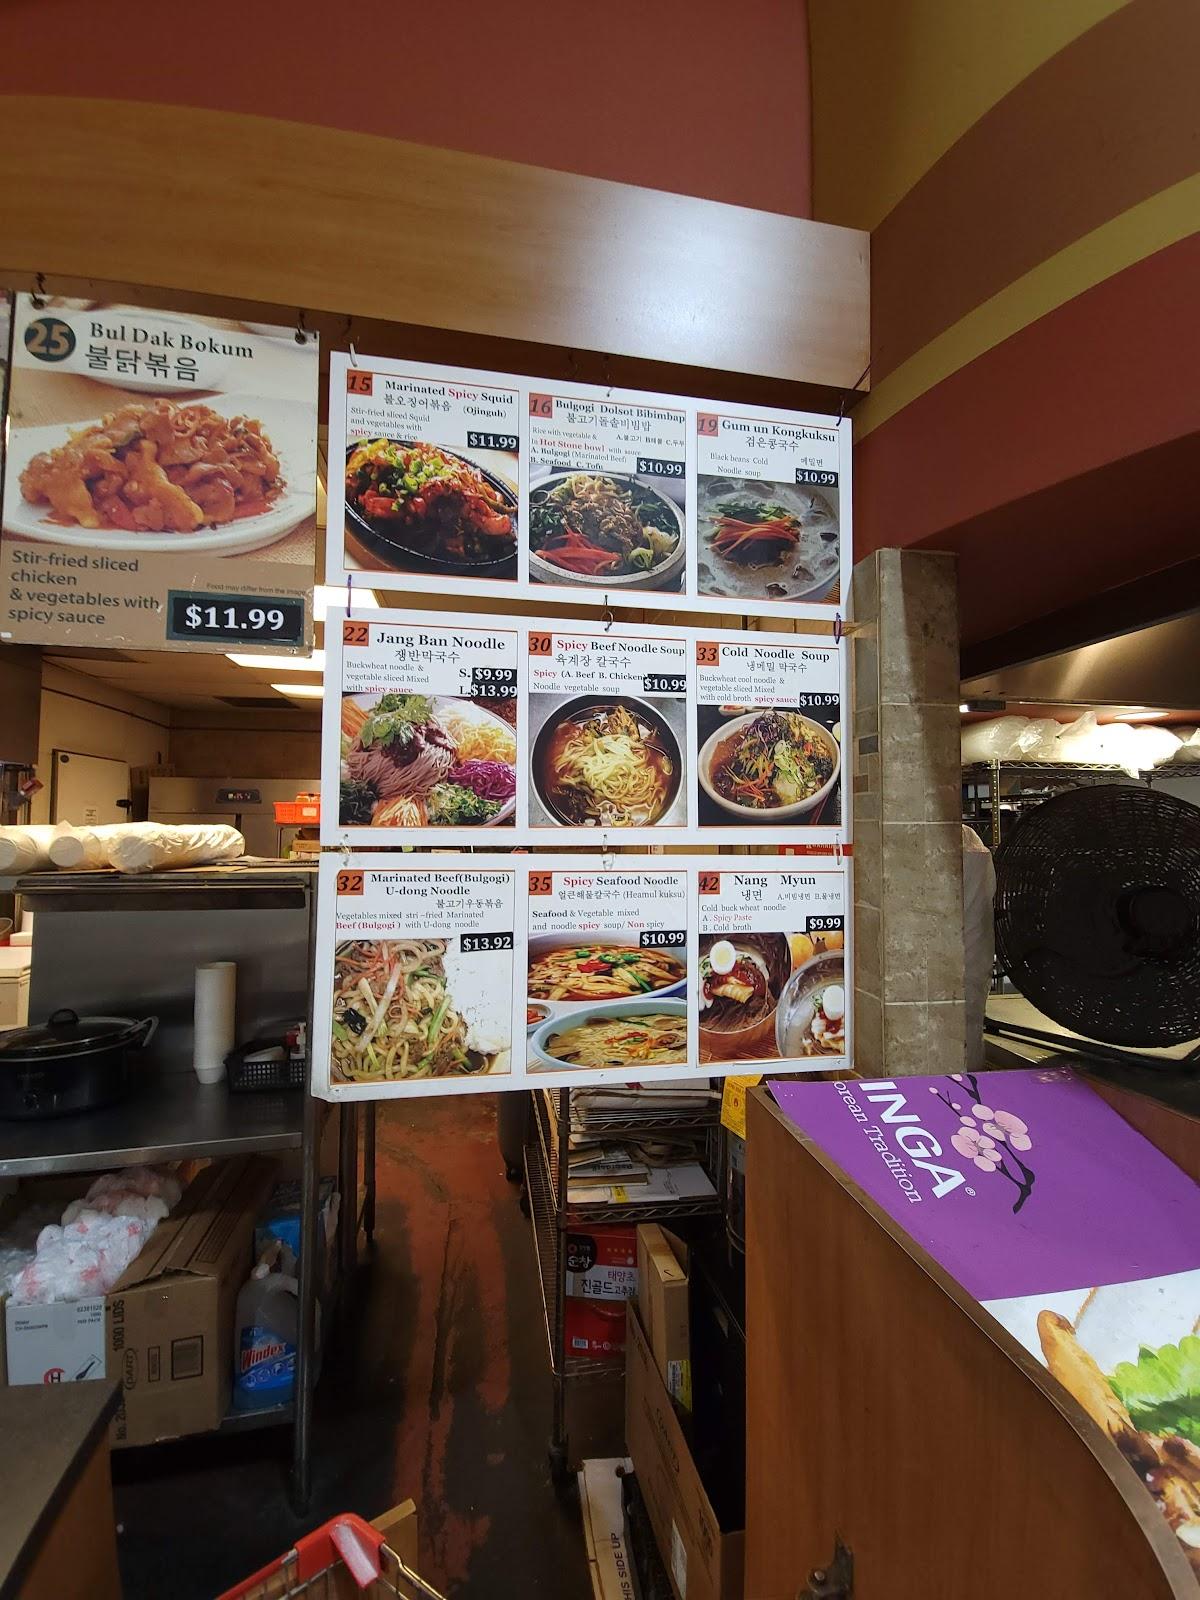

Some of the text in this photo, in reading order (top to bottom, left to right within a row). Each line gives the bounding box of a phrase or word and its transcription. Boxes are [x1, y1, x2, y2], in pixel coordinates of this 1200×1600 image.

[27, 322, 68, 355] 25
[90, 322, 254, 359] Bul Dak Bokum
[85, 345, 200, 382] 불닭볶음
[348, 375, 371, 391] 15
[385, 380, 513, 404] Marinated Spicy Squid
[463, 405, 507, 419] (Ojinguh)
[531, 399, 551, 414] 16
[556, 400, 685, 424] Bulgogi Dolsot Bibimbap
[351, 407, 430, 423] Stir-fried sliced Squid
[367, 420, 404, 431] vegetables
[406, 423, 422, 431] with
[699, 418, 717, 432] 19
[722, 420, 835, 442] Gum un Kongkuksu
[351, 429, 372, 438] spicy
[469, 433, 517, 448] $11.99
[540, 438, 605, 452] Hot Stone bowl
[541, 448, 570, 459] Bulgogi
[711, 452, 768, 465] Black beans Cold
[541, 457, 603, 470] Seafood Tofu
[640, 460, 682, 476] $10.99
[718, 466, 761, 478] Noodle soup
[797, 471, 835, 485] $10.99
[12, 551, 139, 572] Stir-fried sliced
[11, 570, 77, 586] chicken
[10, 588, 160, 609] & vegetables with
[9, 606, 105, 625] spicy sauce
[186, 604, 284, 630] $11.99
[344, 627, 368, 642] 22
[377, 632, 505, 649] Jang Ban Noodle
[529, 638, 550, 651] 30
[557, 640, 685, 656] Spicy Beef Noodle Soup
[395, 649, 460, 664] 쟁반막국수
[697, 647, 717, 661] 33
[722, 647, 830, 663] Cold Noodle Soup
[347, 662, 414, 671] Buckwheat noodle
[555, 654, 631, 669] 육계장 칼국수
[347, 673, 429, 683] vegetable sliced Mixed
[475, 668, 512, 680] $9.99
[534, 670, 595, 679] Spicy Beef
[700, 674, 736, 683] Buckwheat
[471, 685, 517, 698] $13.99
[534, 683, 620, 693] Noodle vegetable soup
[644, 678, 686, 691] $10.99
[700, 685, 732, 693] vegetable
[754, 696, 774, 704] spicy
[801, 695, 839, 706] $10.99
[338, 875, 363, 891] 32
[371, 873, 510, 884] Marinated Beef(Bulgogi)
[529, 877, 551, 891] 35
[564, 876, 679, 887] Spicy Seafood Noodle
[699, 877, 719, 891] 42
[734, 875, 816, 887] Nang Myun
[386, 886, 470, 896] U-dong Noodle
[659, 890, 685, 899] kuksu)
[742, 889, 763, 901] 냉면
[533, 909, 640, 918] Seafood Vegetable mixed
[702, 904, 718, 912] Cold
[405, 921, 422, 929] with
[424, 921, 451, 930] U-dong
[533, 923, 547, 931] and
[551, 922, 577, 930] noodle
[579, 922, 600, 930] spicy
[647, 920, 664, 929] spicy
[714, 914, 732, 923] Spicy
[810, 918, 841, 929] $9.99
[464, 937, 511, 951] $13.92
[642, 933, 684, 945] $10.99
[832, 1080, 922, 1203] orean Tradition
[859, 1081, 966, 1199] INGA
[568, 1256, 592, 1269] 순창
[240, 1342, 288, 1373] Windex
[611, 1532, 632, 1600] HIS SIDE UP
